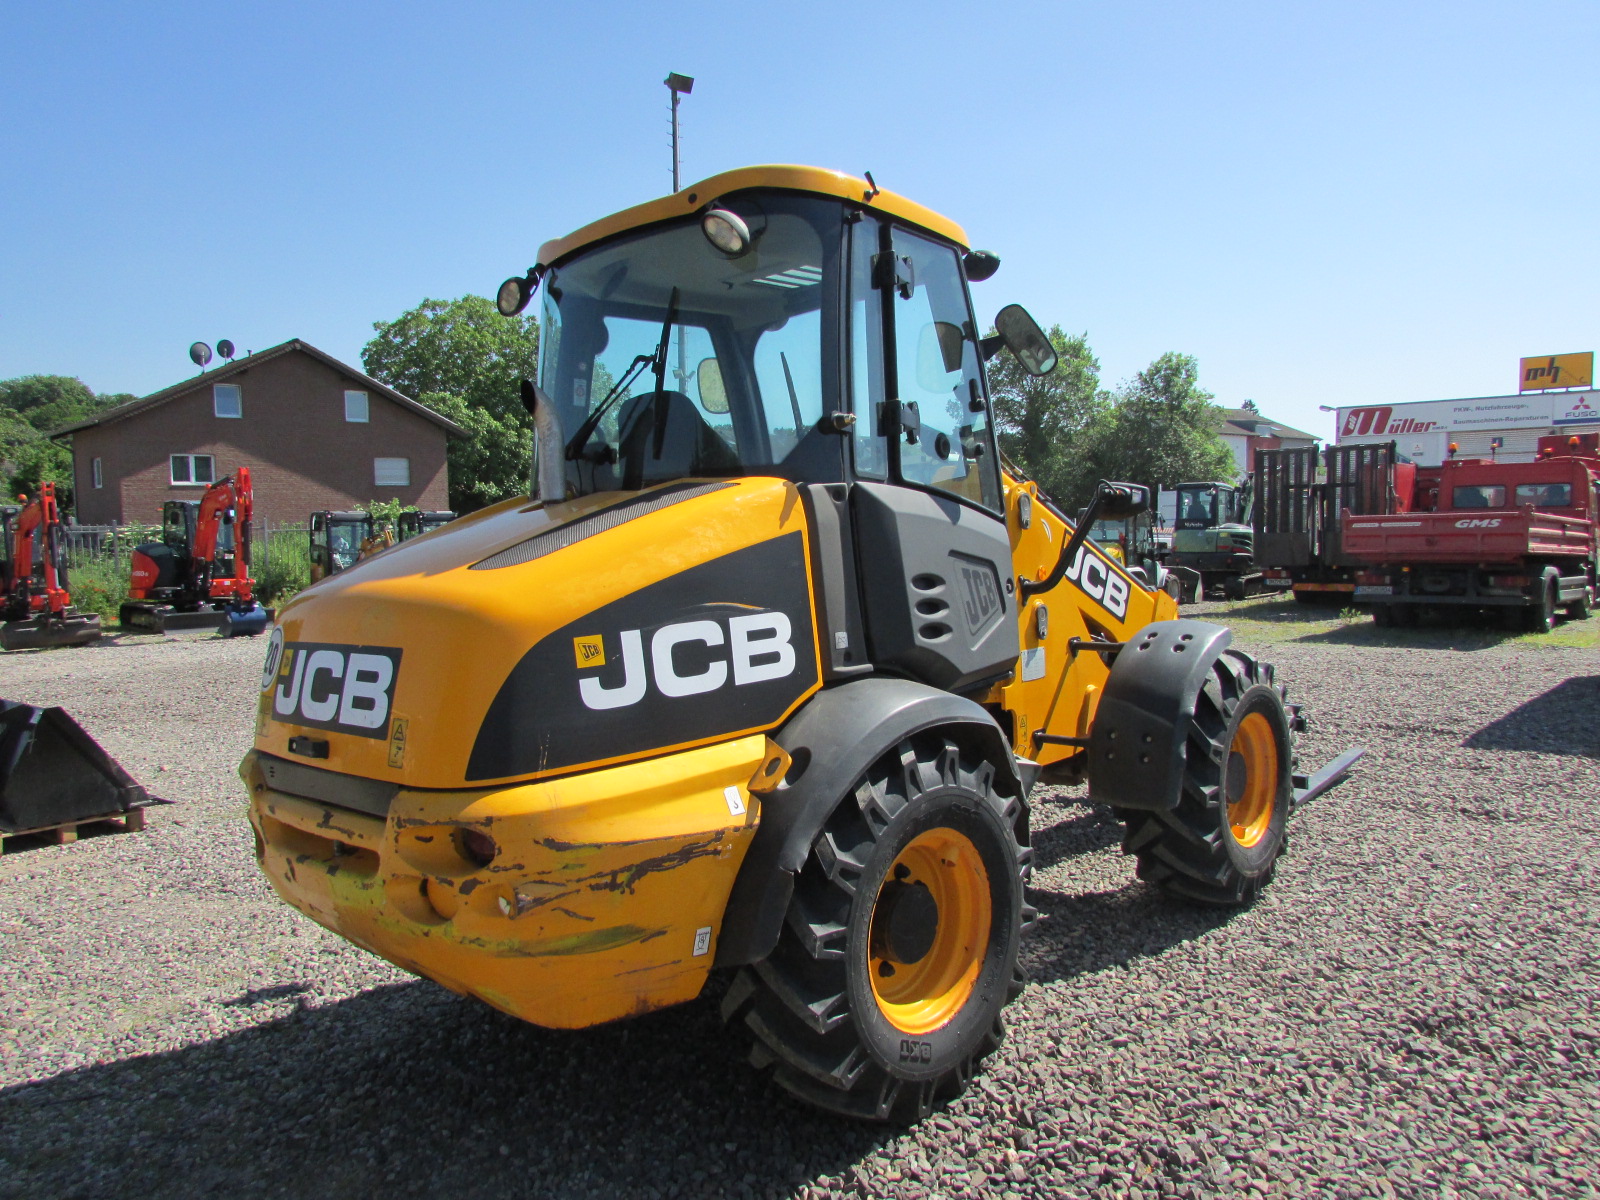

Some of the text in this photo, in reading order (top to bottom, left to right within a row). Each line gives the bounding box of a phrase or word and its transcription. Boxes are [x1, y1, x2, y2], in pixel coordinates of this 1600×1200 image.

[1341, 407, 1437, 436] Müller
[1455, 518, 1502, 528] GMS
[961, 567, 998, 626] JCB
[1065, 545, 1129, 618] JCB
[578, 611, 796, 710] JCB
[582, 644, 600, 659] JCB
[275, 649, 394, 729] JCB
[900, 1039, 932, 1063] BKT
